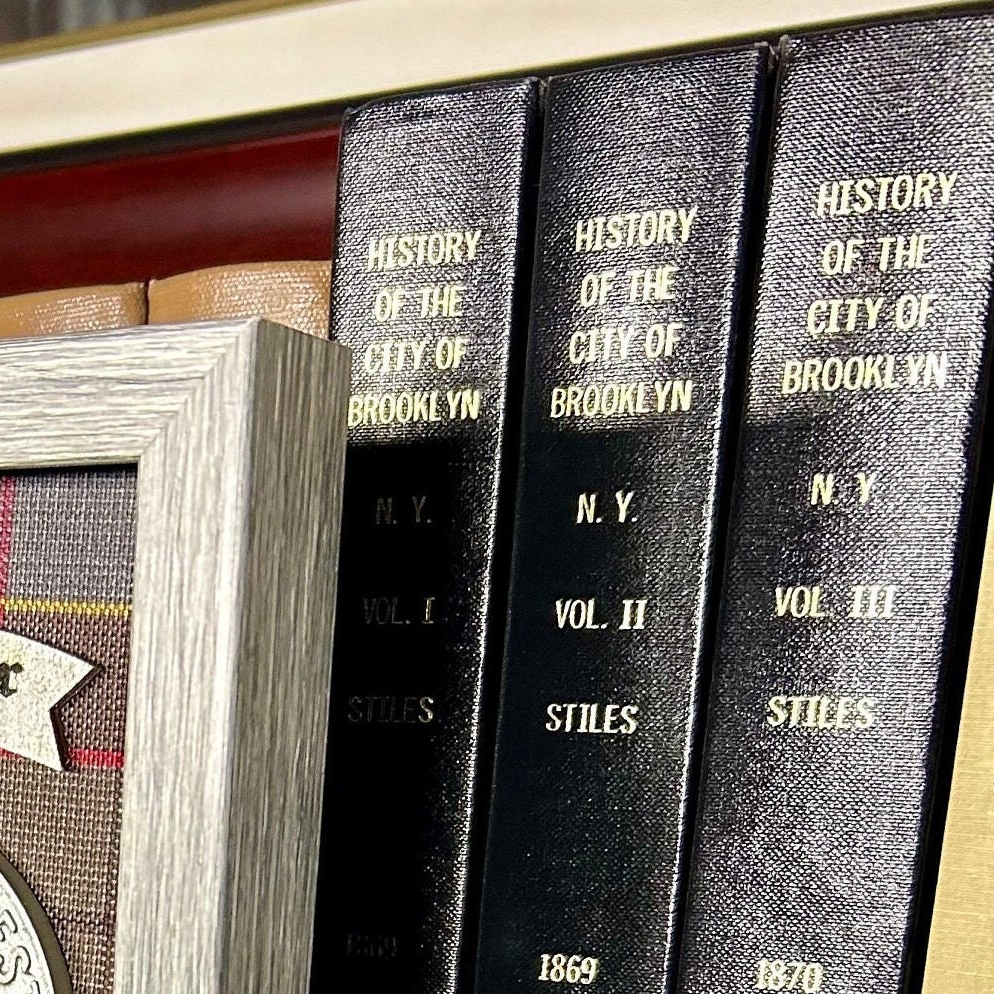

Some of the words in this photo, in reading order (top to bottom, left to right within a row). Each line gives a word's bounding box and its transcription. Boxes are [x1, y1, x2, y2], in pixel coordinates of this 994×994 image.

[816, 172, 957, 217] HISTORY
[576, 206, 698, 250] HISTORY
[367, 229, 482, 271] HISTORY
[822, 238, 865, 275] OF
[877, 233, 935, 271] THE
[374, 287, 407, 322] OF
[417, 283, 466, 318] THE
[580, 272, 615, 307] OF
[626, 264, 677, 302] THE
[807, 296, 883, 338] CITY
[896, 293, 938, 331] OF
[364, 340, 426, 373] CITY
[435, 335, 470, 370] OF
[569, 325, 635, 364] CITY
[644, 323, 682, 360] OF
[782, 351, 947, 394] BROOKLYN
[348, 389, 481, 427] BROOKLYN
[550, 379, 693, 418] BROOKLYN
[375, 497, 398, 524] N.
[412, 495, 432, 523] Y.
[576, 492, 603, 523] N.
[615, 490, 638, 523] Y.
[362, 597, 410, 625] VOL.
[421, 597, 436, 624] I
[555, 598, 608, 629] VOL.
[619, 599, 648, 629] II
[848, 584, 897, 618] III
[347, 696, 434, 723] STILES
[545, 702, 639, 734] STILES
[767, 696, 876, 730] STILES
[538, 953, 599, 985] 1869
[756, 958, 824, 993] 1870
